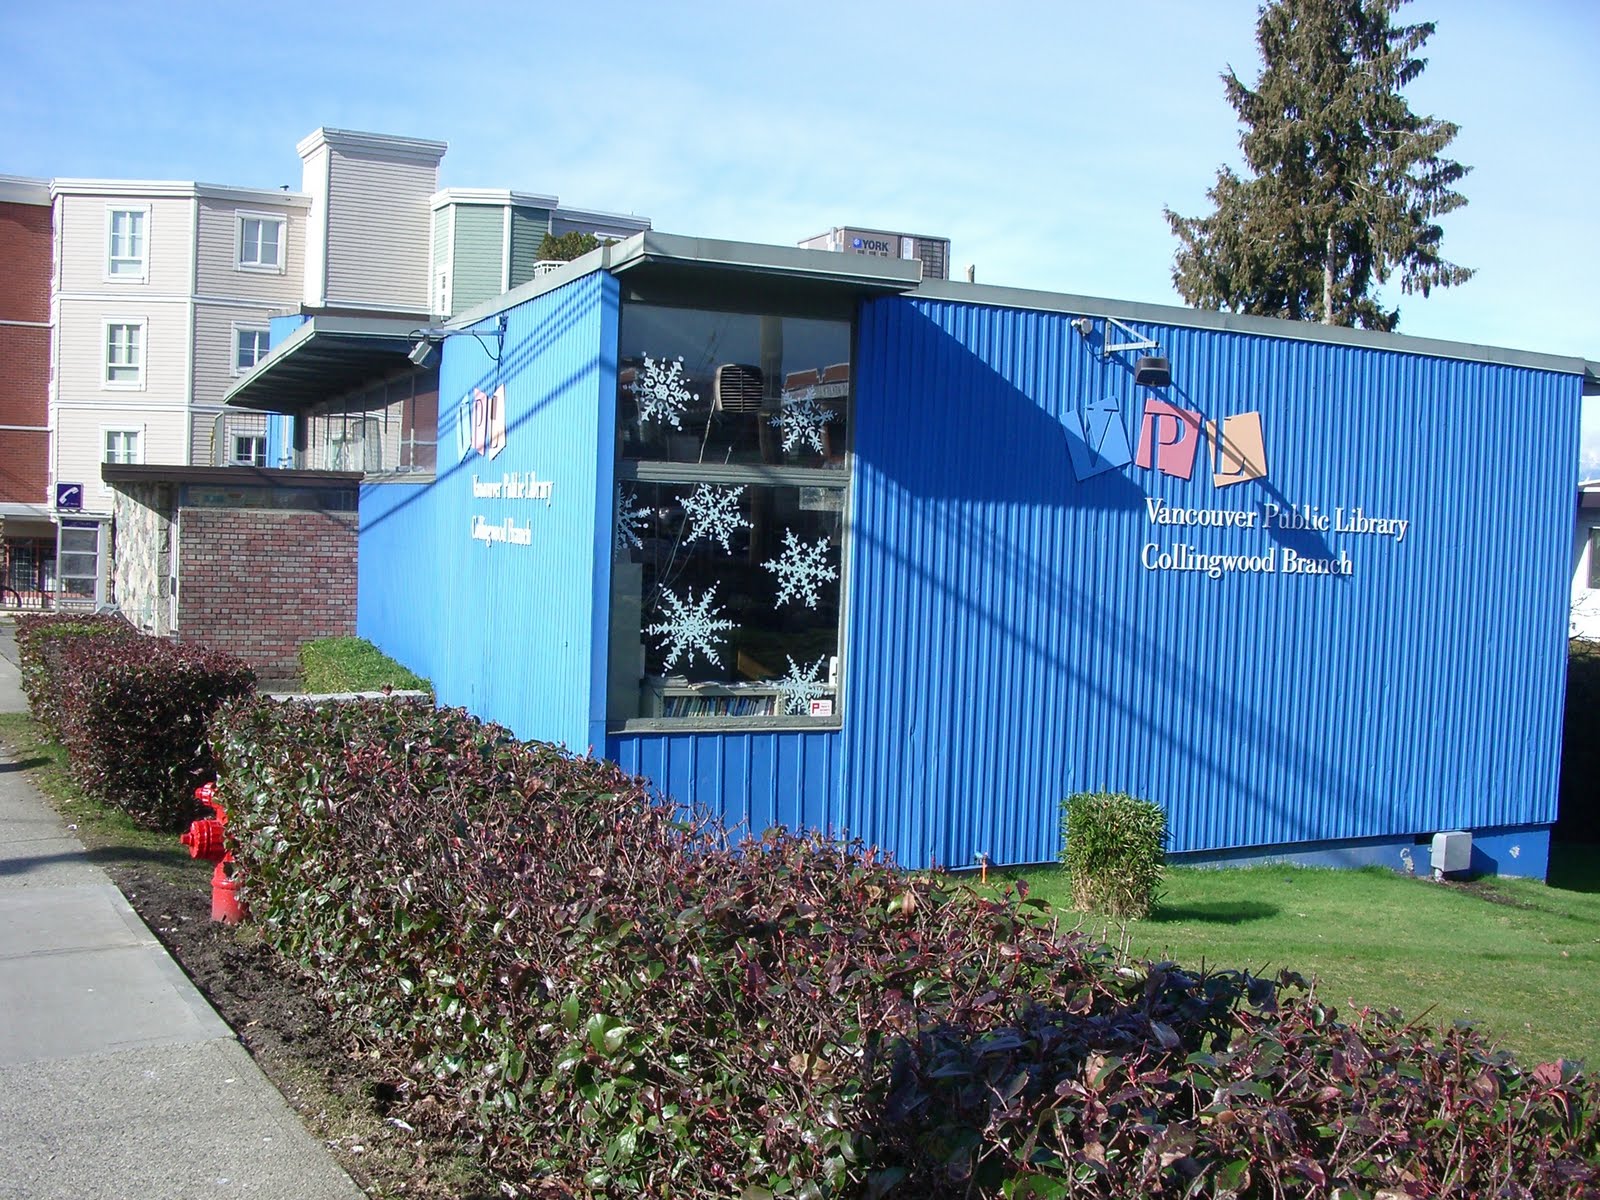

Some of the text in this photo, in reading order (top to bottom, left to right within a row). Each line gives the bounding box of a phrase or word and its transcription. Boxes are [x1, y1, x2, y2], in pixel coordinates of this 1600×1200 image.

[862, 239, 889, 252] YORK
[1061, 399, 1258, 483] VPL
[1145, 497, 1409, 542] Vancouver Public Library
[1141, 543, 1354, 579] Collingwood Branch
